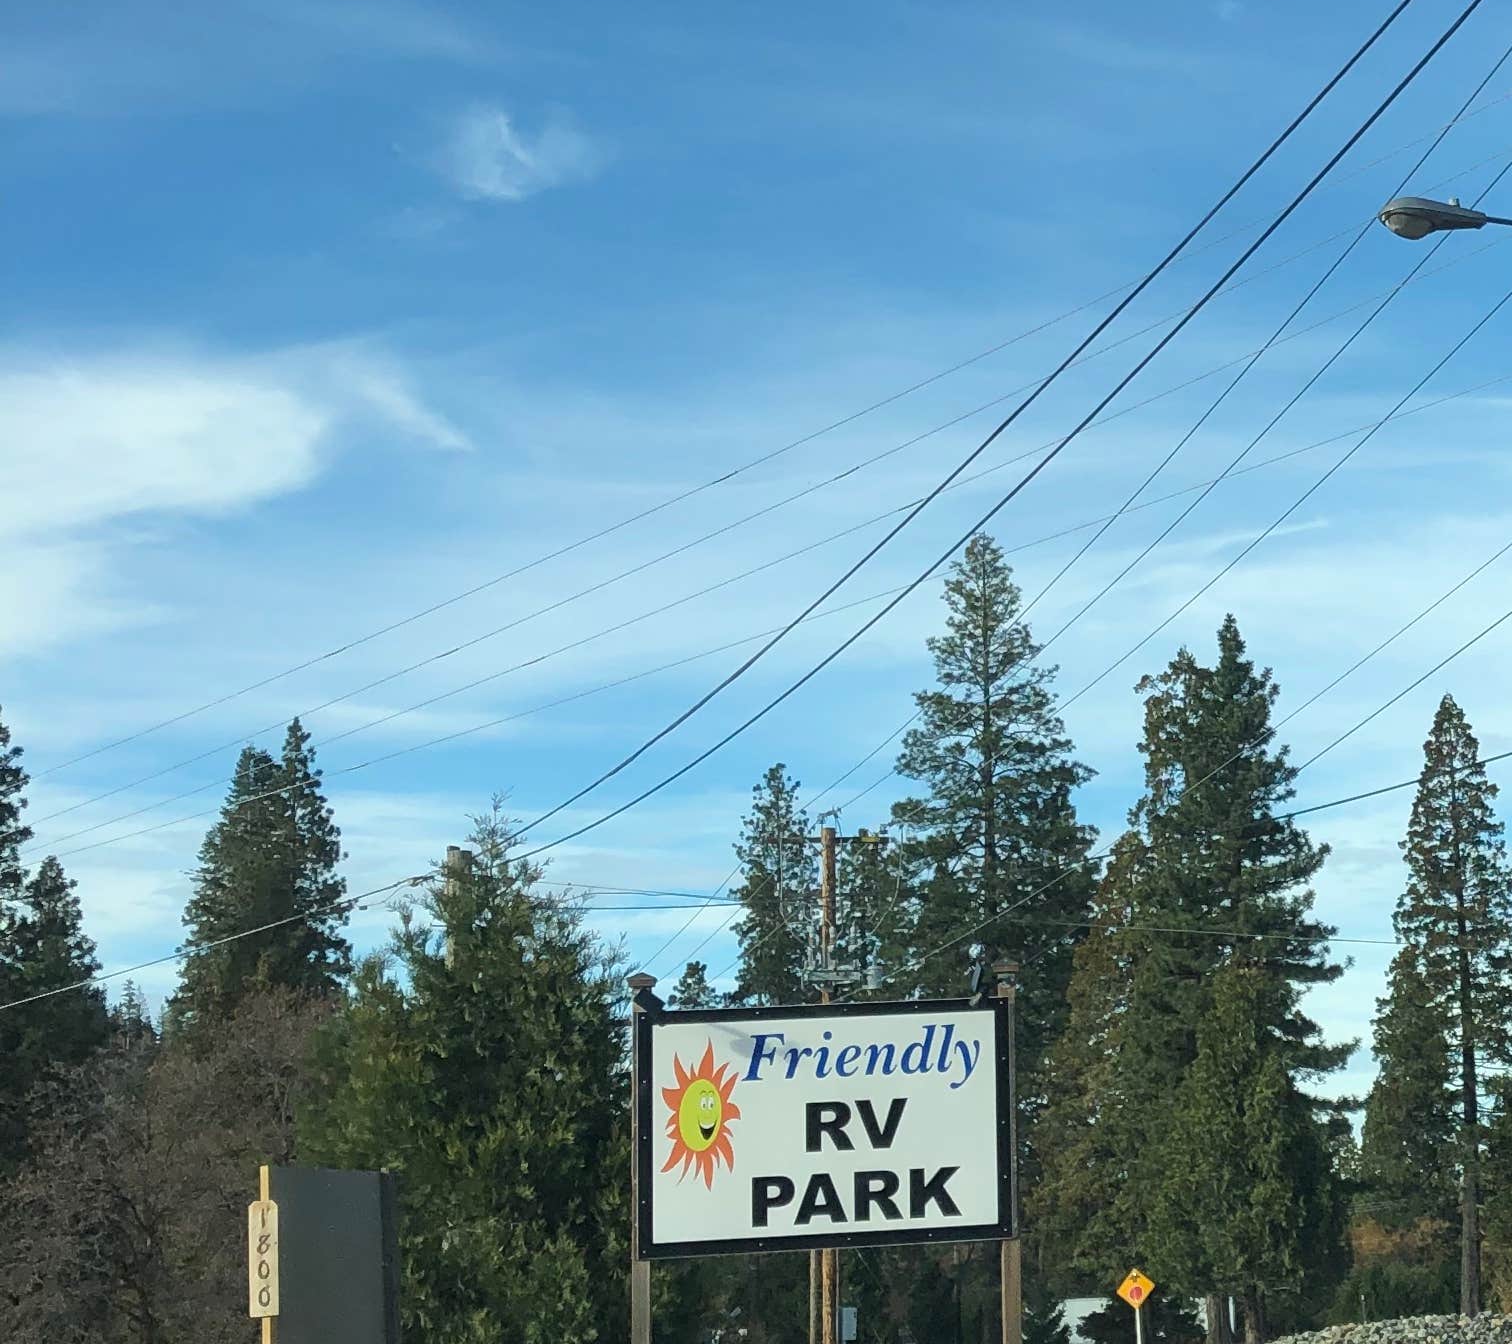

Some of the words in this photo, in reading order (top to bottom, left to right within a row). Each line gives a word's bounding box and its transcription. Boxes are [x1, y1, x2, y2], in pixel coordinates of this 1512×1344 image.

[741, 1023, 981, 1089] Friendly
[805, 1097, 908, 1153] RV
[751, 1166, 962, 1228] PARK
